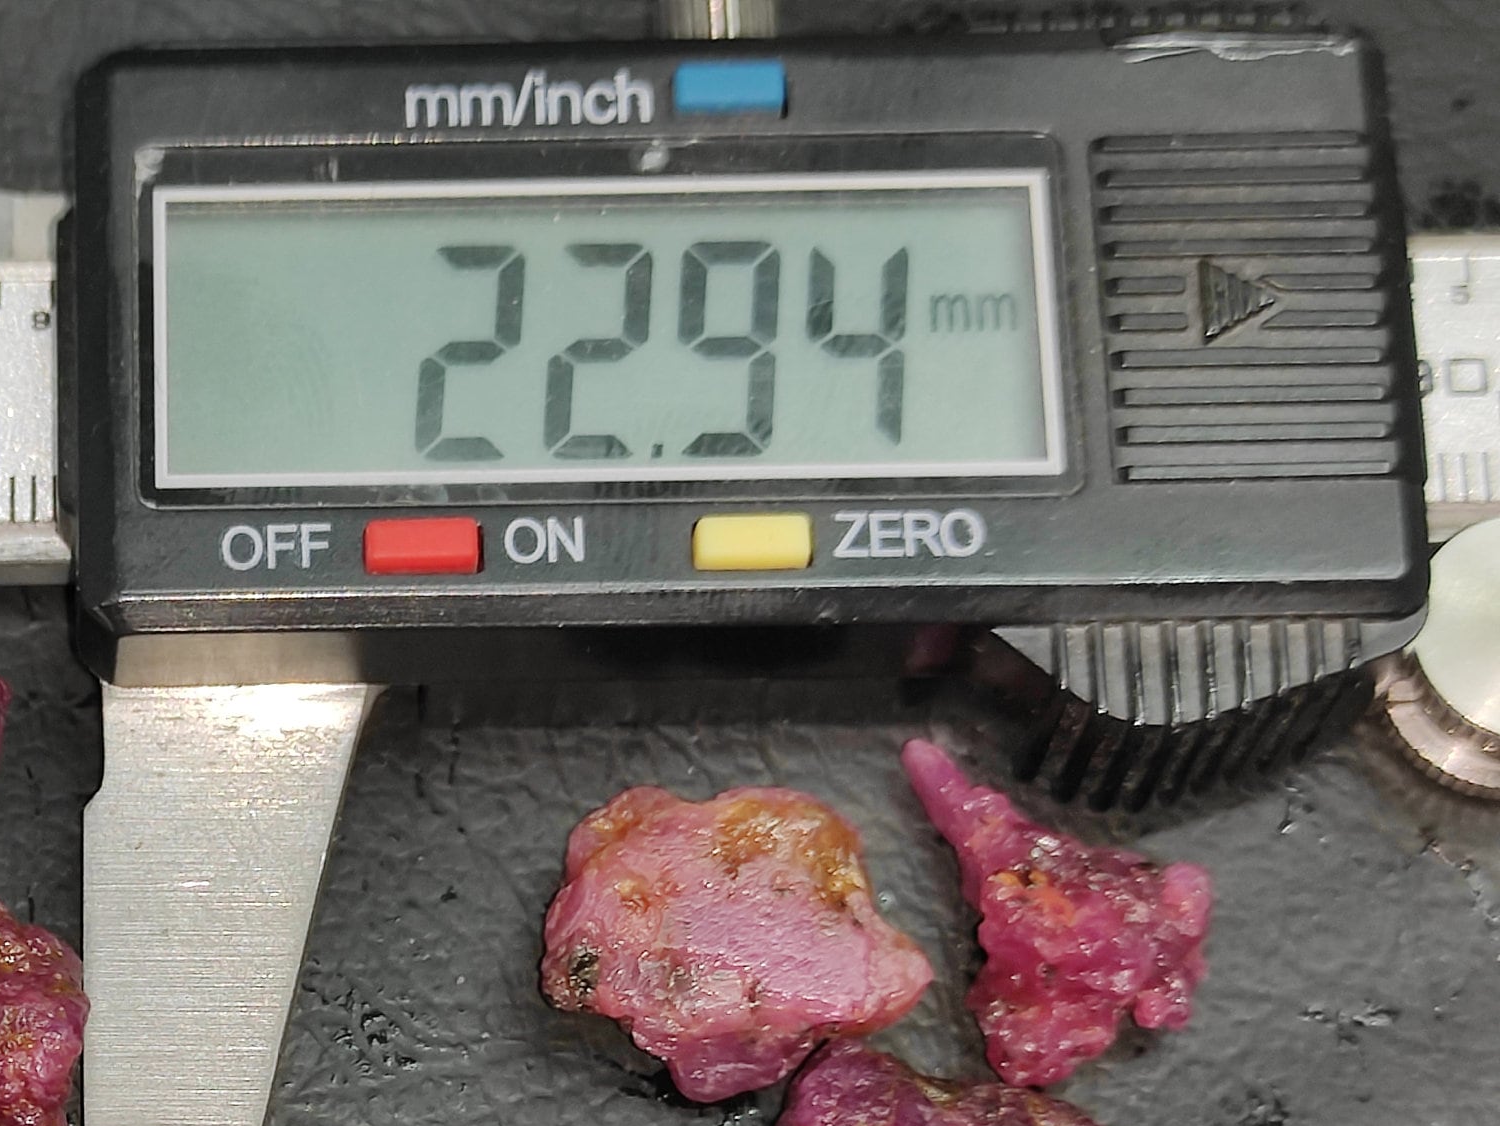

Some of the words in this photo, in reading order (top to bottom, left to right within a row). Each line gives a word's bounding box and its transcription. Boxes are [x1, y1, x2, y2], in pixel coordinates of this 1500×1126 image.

[404, 69, 654, 129] mm/inch
[414, 240, 909, 462] 22.94
[928, 292, 1017, 334] mm
[220, 522, 332, 572] OFF
[503, 516, 586, 564] ON
[832, 509, 987, 559] ZERO
